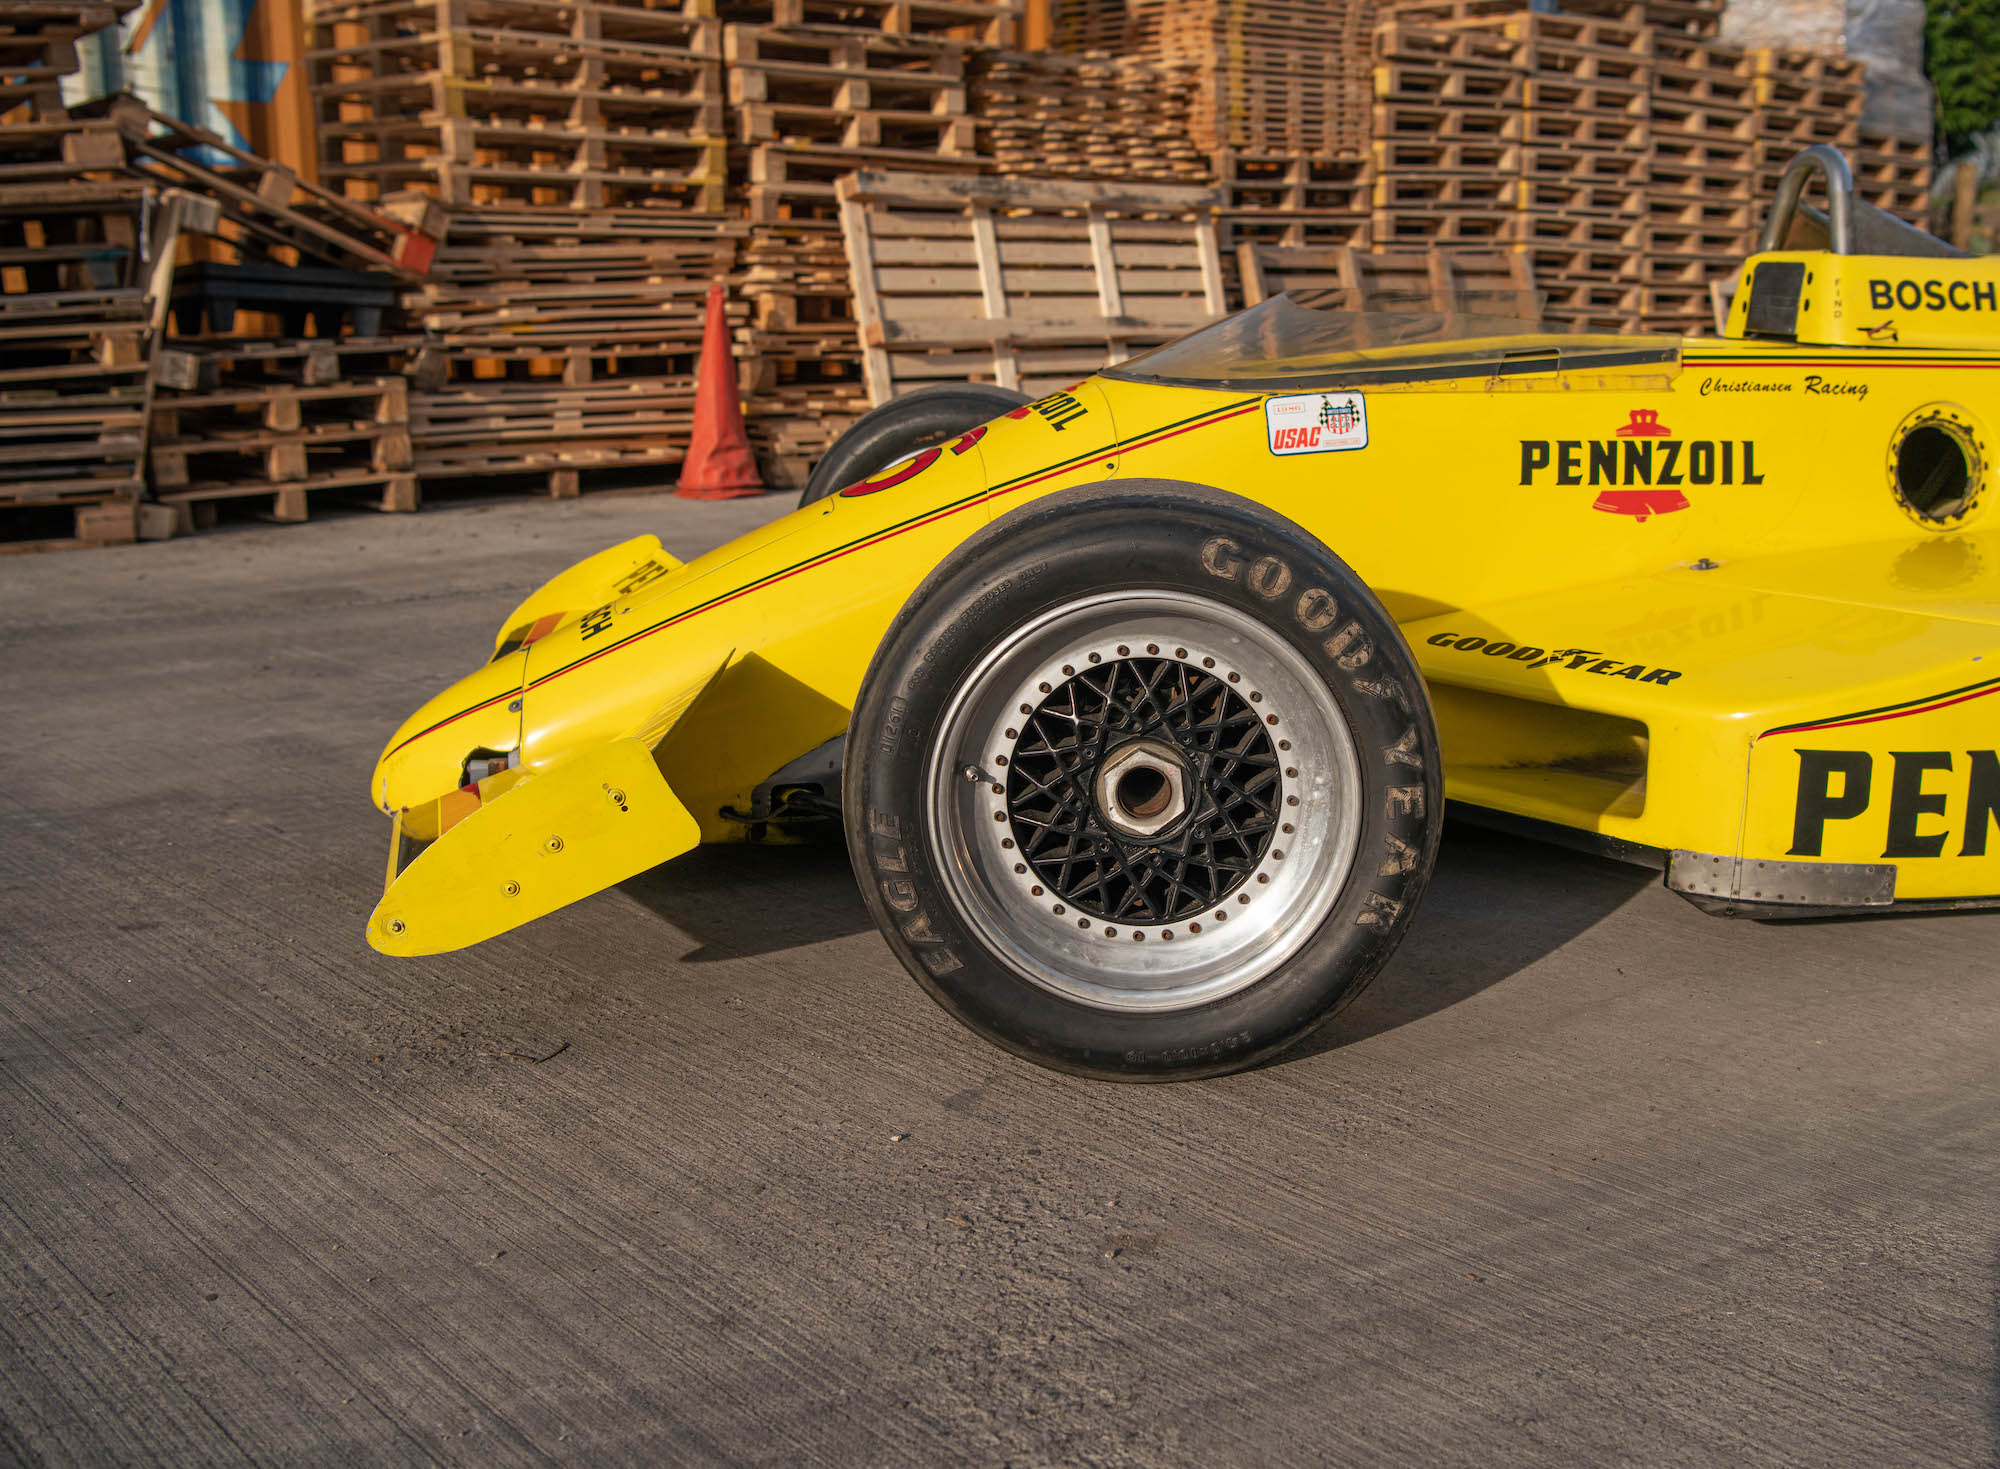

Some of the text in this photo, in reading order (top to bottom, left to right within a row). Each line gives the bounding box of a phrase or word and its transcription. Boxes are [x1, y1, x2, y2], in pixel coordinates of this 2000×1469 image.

[1869, 280, 1997, 311] BOSCH
[1700, 375, 1869, 402] Christiansen Racing
[1273, 426, 1321, 450] USAC
[1518, 440, 1766, 486] PENNZOIL
[924, 624, 958, 662] RACING
[960, 580, 1012, 622] PURPOSES
[1019, 562, 1049, 581] ONLY
[868, 807, 965, 977] EAGLE
